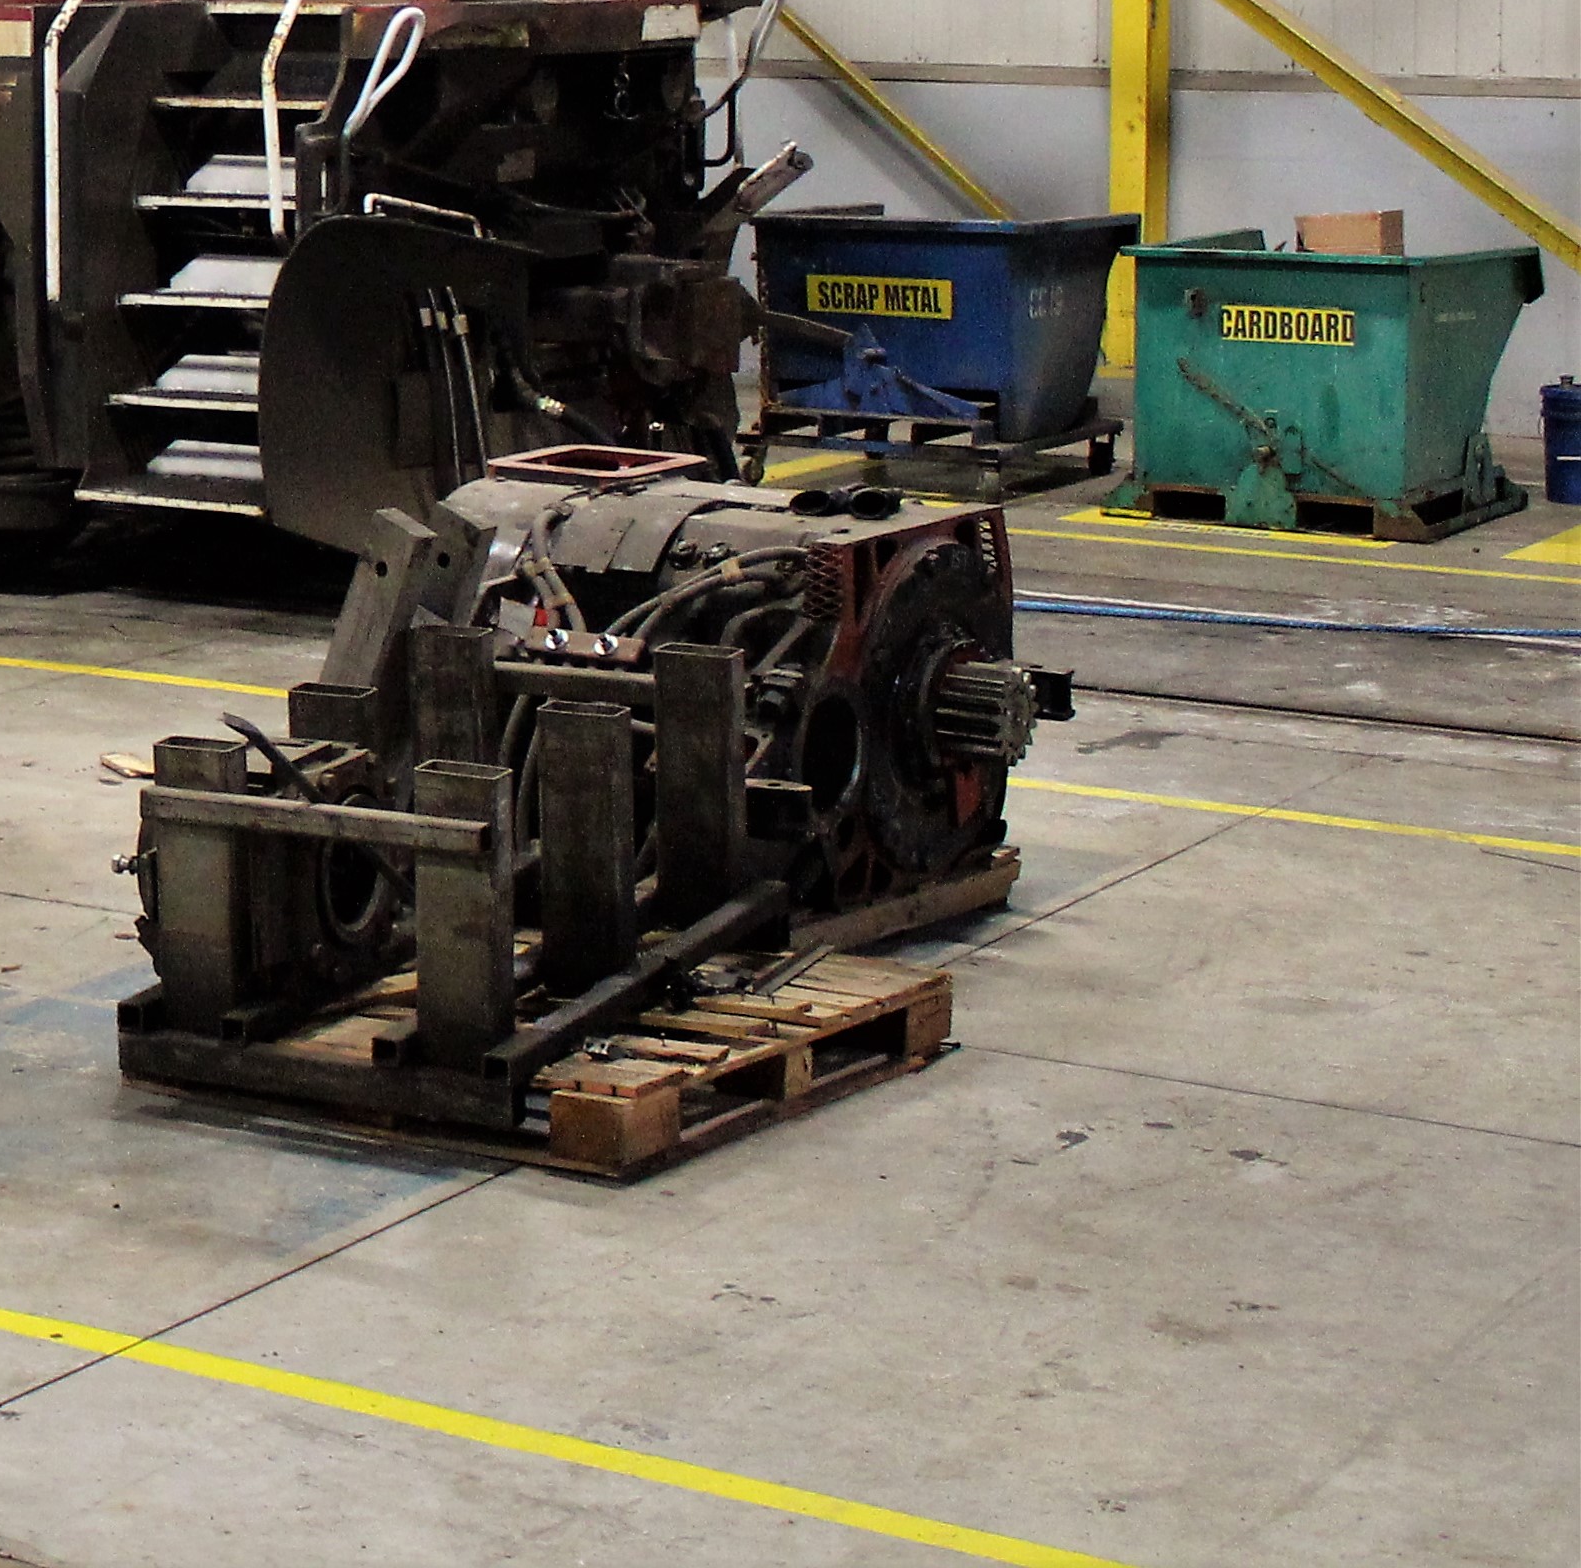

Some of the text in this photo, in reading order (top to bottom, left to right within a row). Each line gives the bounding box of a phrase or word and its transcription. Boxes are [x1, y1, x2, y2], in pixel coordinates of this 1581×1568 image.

[817, 281, 942, 314] SCRAP METAL
[1221, 308, 1356, 343] CARDBOARD
